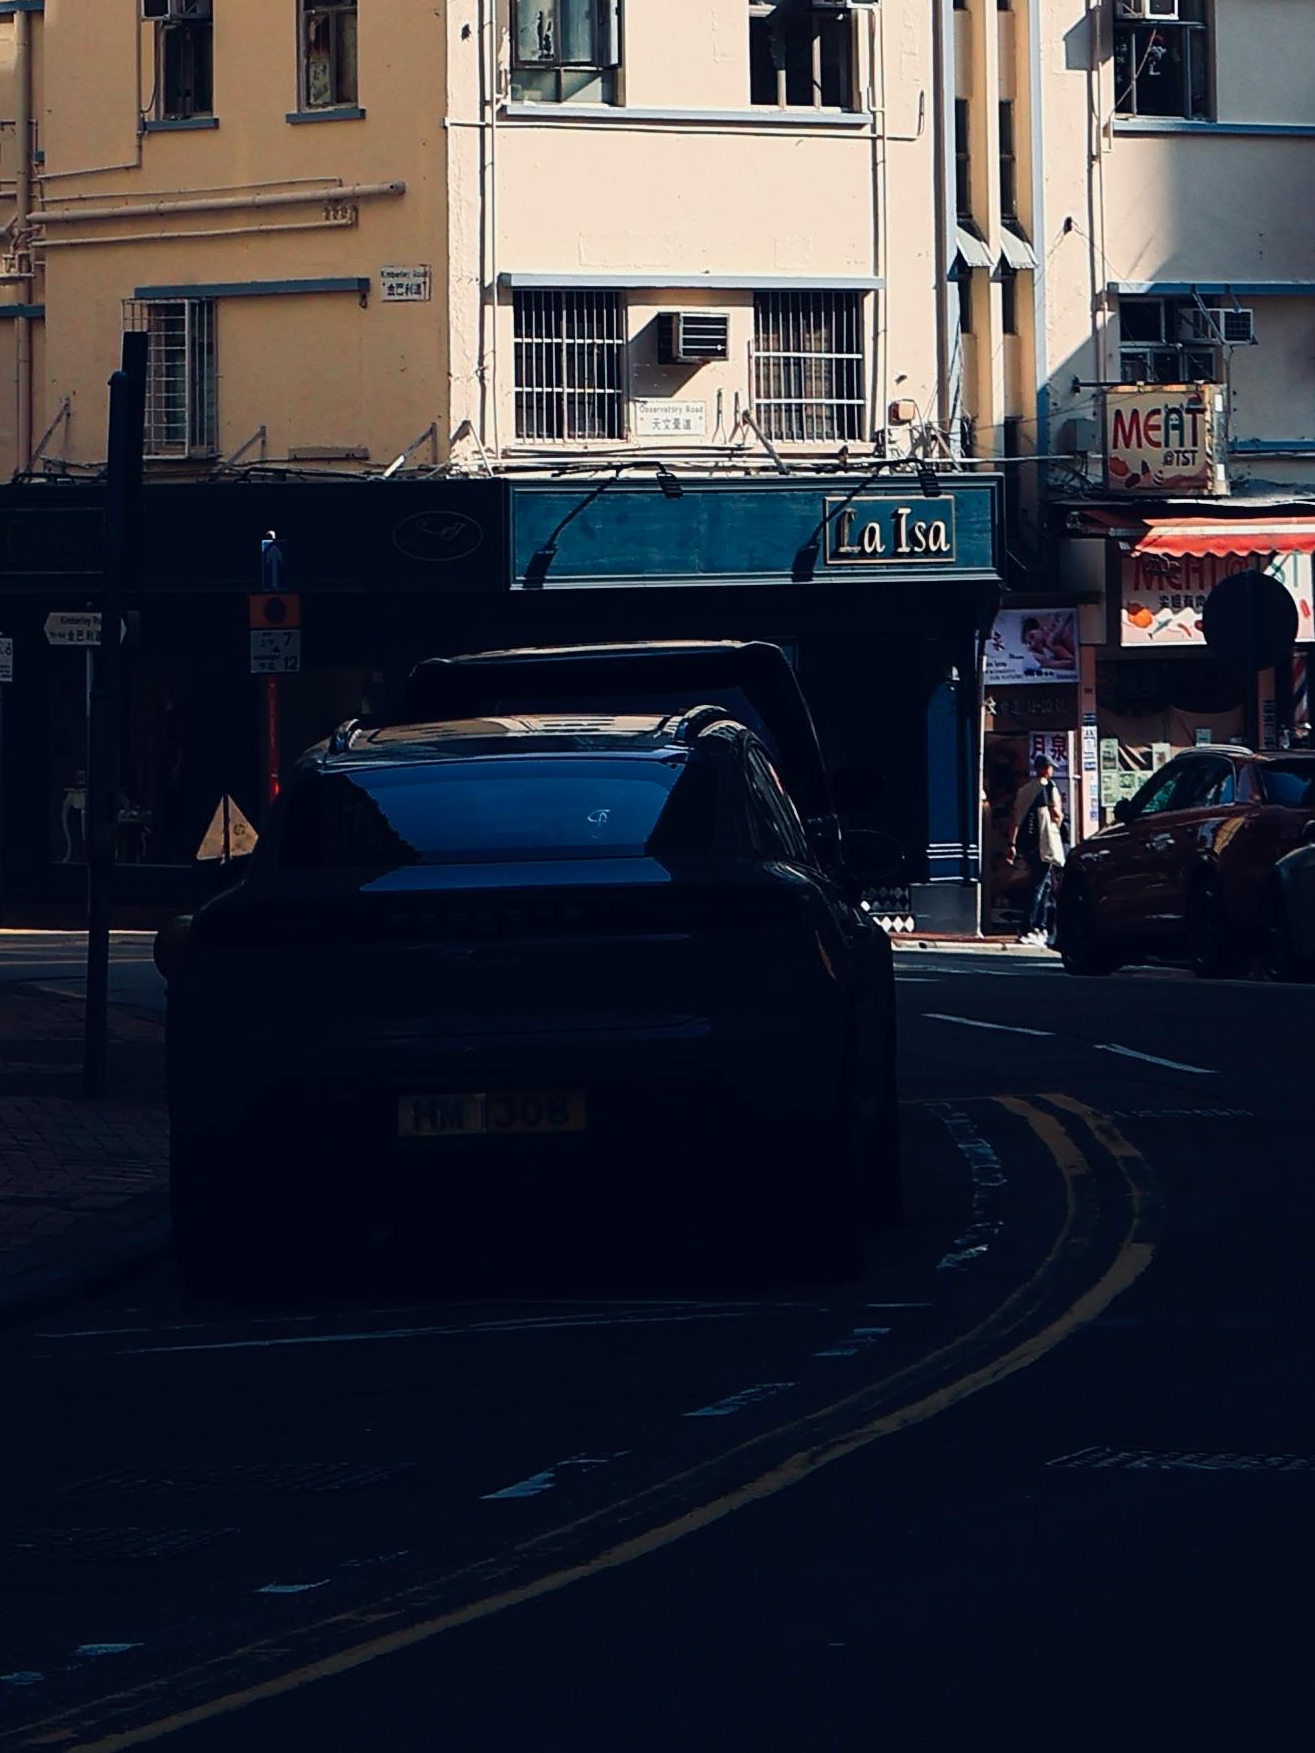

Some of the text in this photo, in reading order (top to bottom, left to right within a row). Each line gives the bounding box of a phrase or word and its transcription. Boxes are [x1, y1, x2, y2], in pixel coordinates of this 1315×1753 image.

[638, 404, 703, 414] Observatory Road
[1112, 400, 1206, 449] MEAT
[1164, 450, 1198, 467] @TST
[837, 507, 951, 554] La Isa
[283, 632, 292, 647] 7
[283, 655, 298, 670] 12
